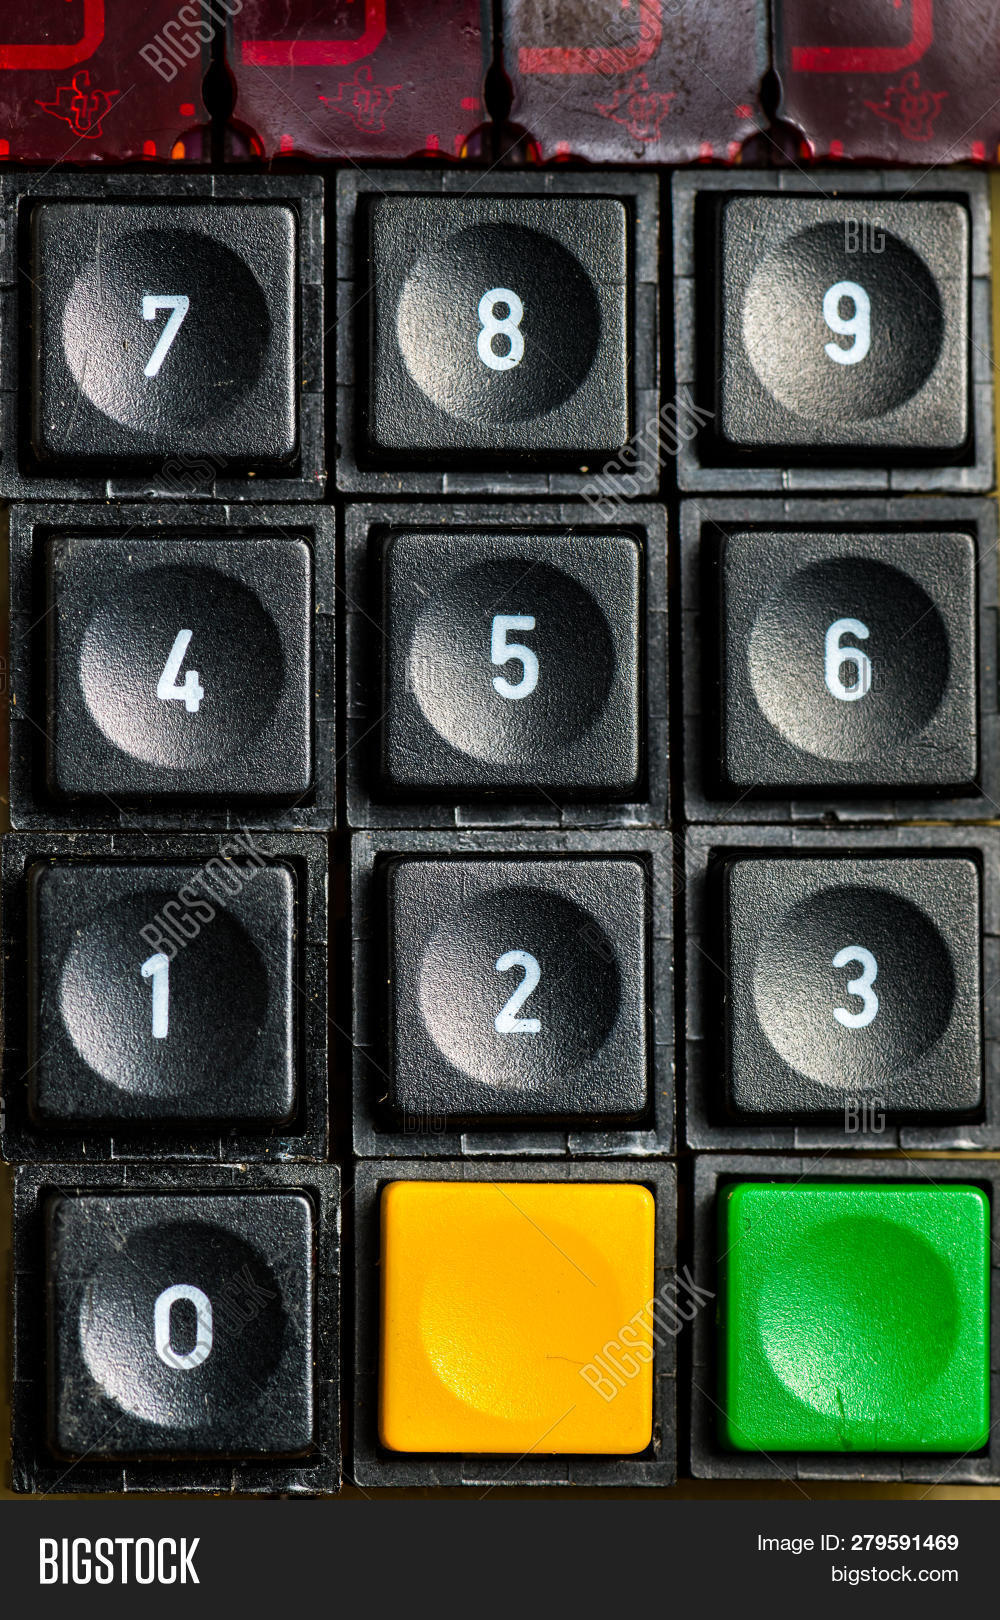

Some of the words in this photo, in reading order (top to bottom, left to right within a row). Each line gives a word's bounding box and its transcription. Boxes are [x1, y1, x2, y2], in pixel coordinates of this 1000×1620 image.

[142, 295, 190, 378] 7
[477, 288, 525, 371] 8
[822, 281, 871, 366] 9
[156, 629, 205, 713] 4
[491, 615, 540, 701] 5
[824, 618, 872, 701] 6
[140, 953, 169, 1039] 1
[495, 950, 542, 1034] 2
[832, 945, 879, 1030] 3
